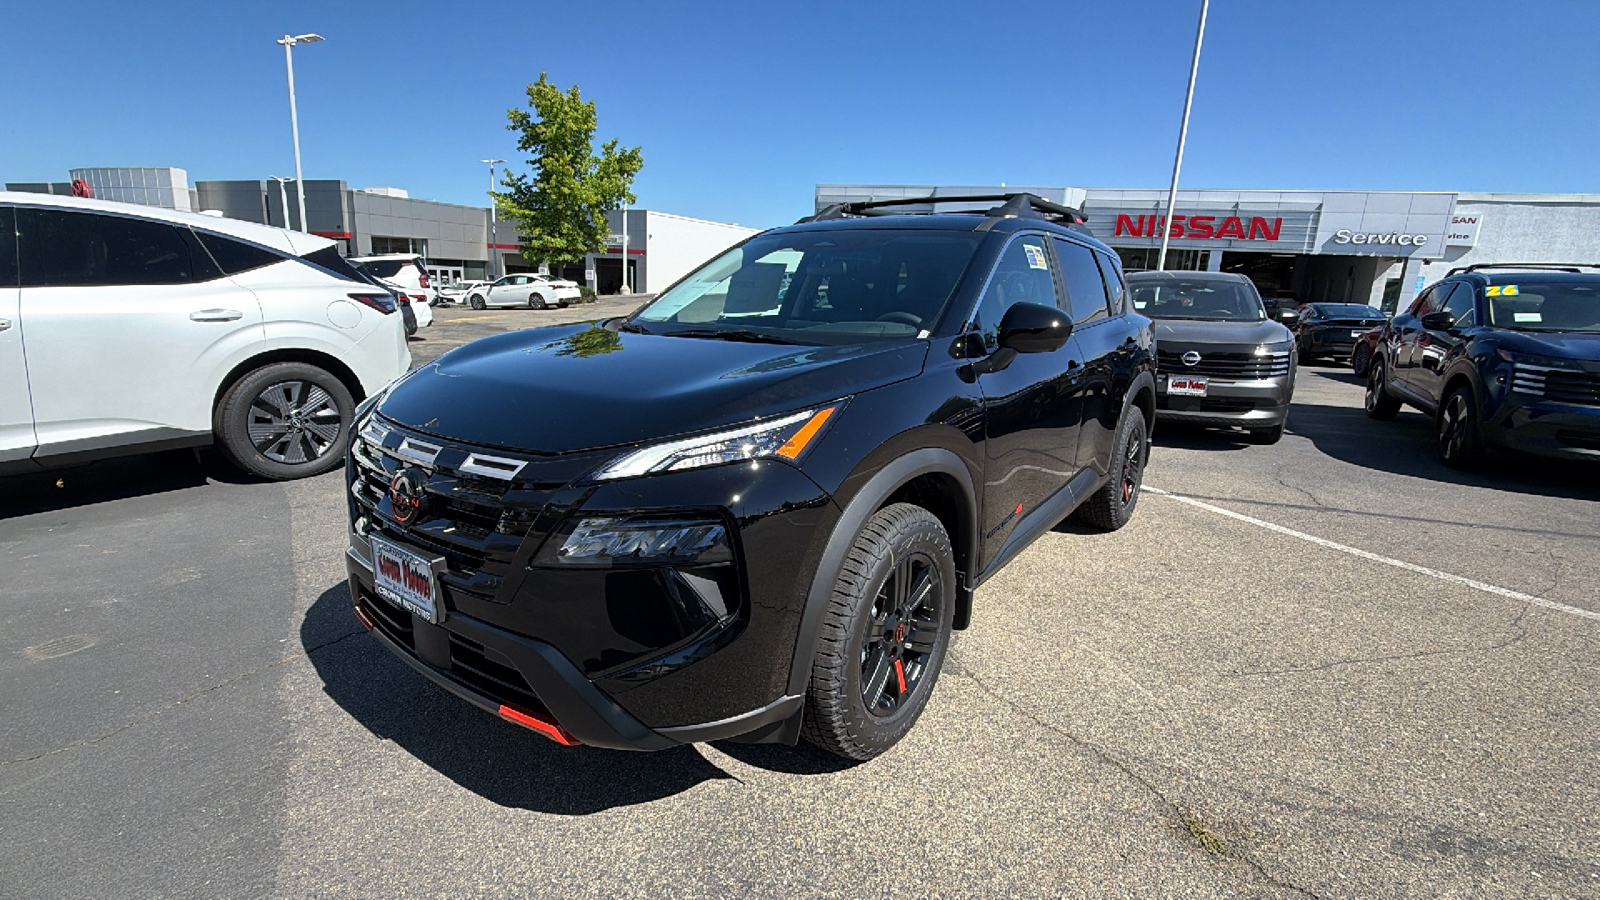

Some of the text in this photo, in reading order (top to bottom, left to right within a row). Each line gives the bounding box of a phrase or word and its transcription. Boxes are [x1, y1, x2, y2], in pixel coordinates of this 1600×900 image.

[1115, 214, 1283, 241] NISSAN
[1334, 229, 1428, 246] Service
[1485, 285, 1518, 297] 26
[402, 598, 431, 621] MOTORS
